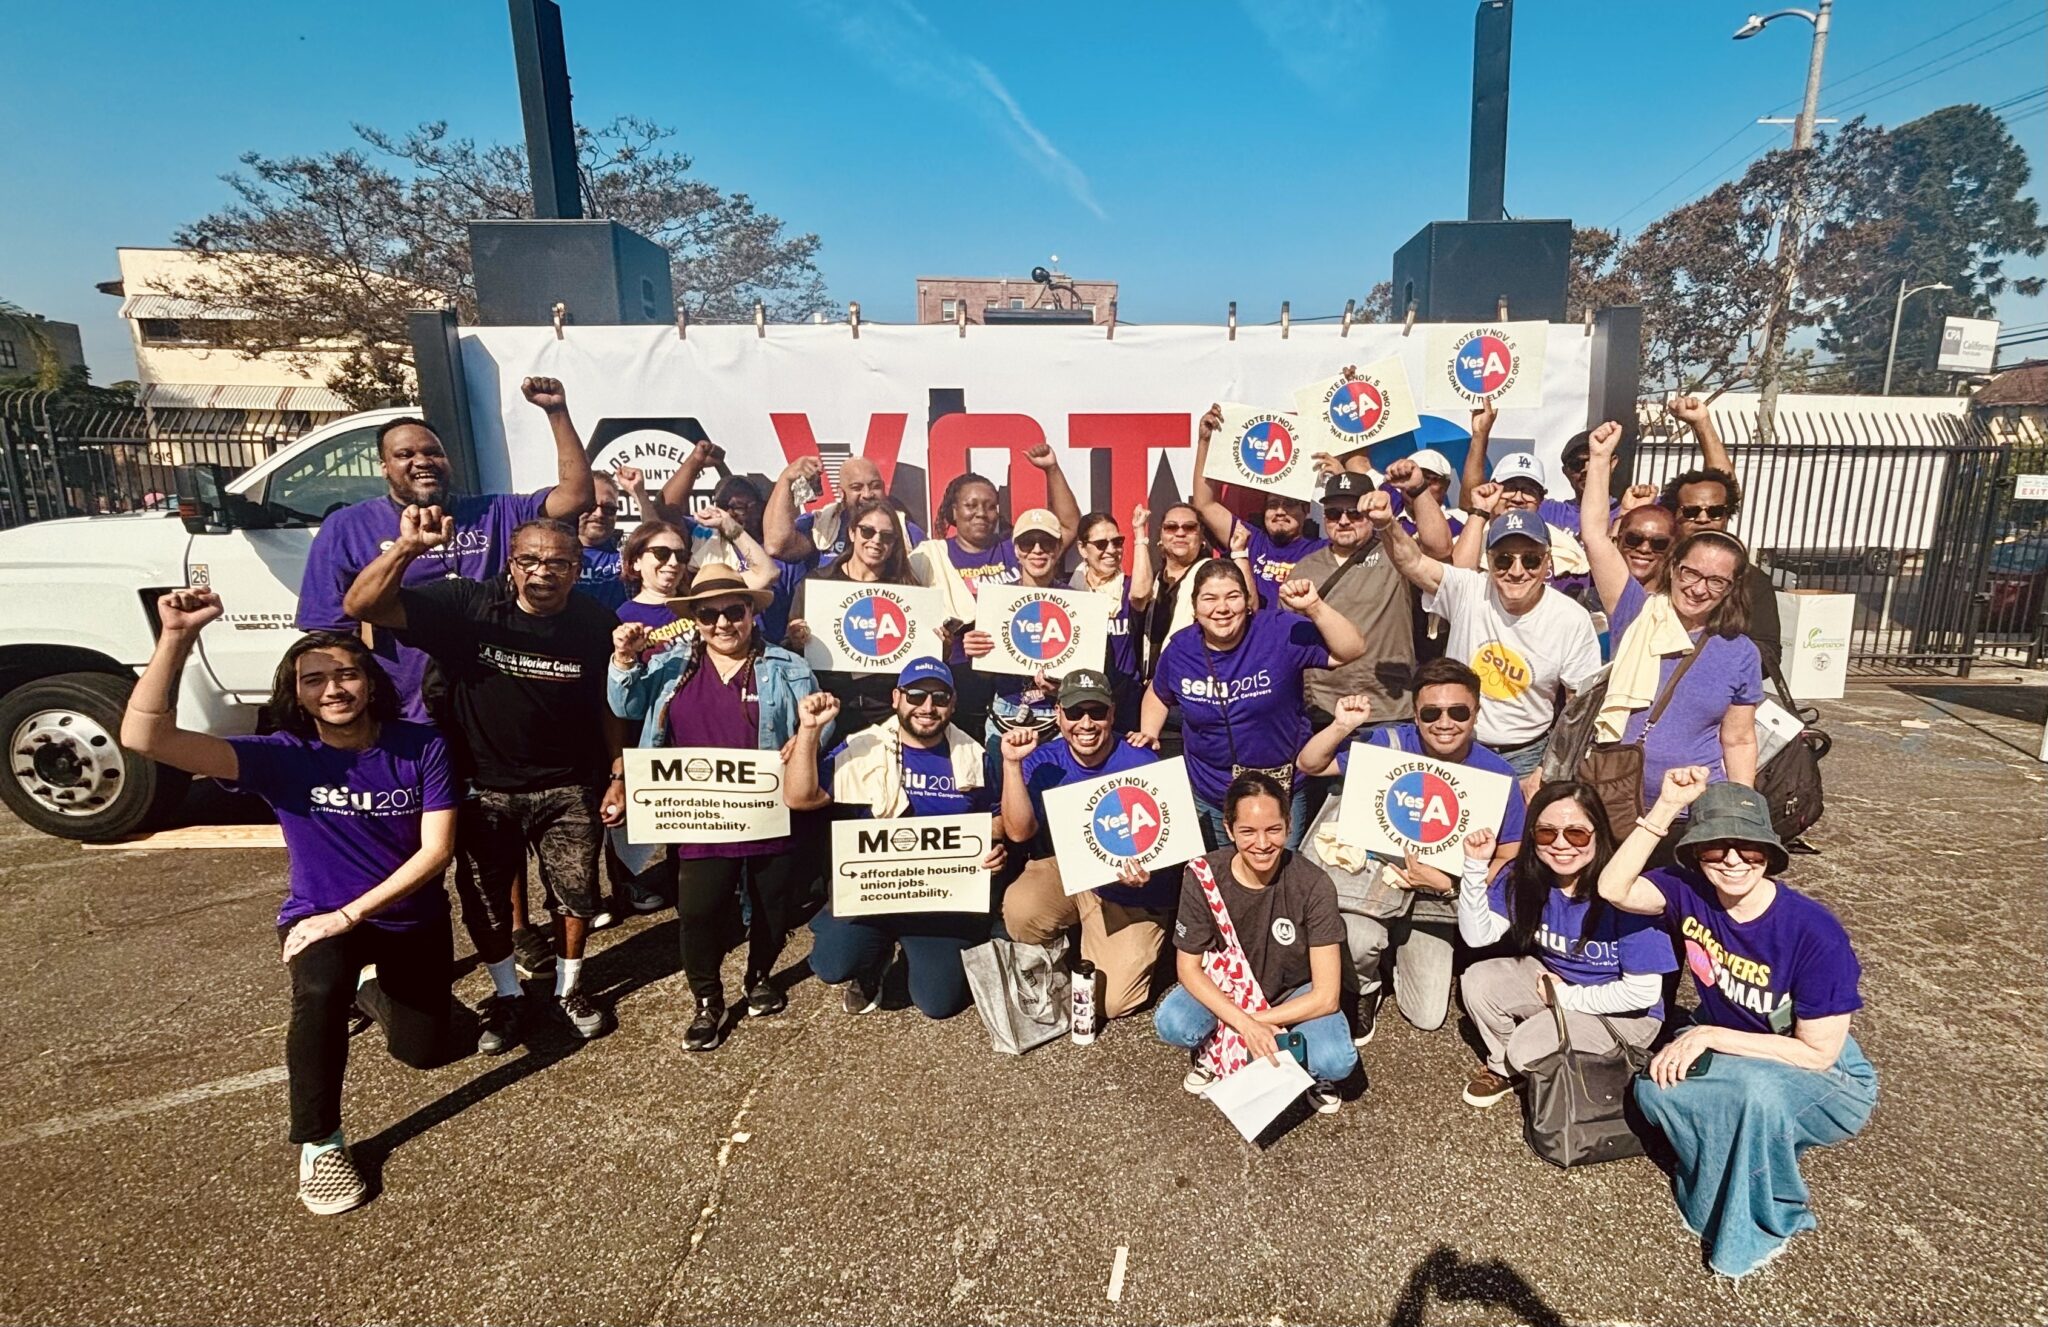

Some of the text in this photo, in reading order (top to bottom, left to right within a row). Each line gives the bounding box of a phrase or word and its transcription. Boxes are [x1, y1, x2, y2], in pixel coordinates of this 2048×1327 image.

[1453, 331, 1475, 351] VOTE
[1476, 328, 1489, 337] BY
[1509, 342, 1517, 350] 5
[1460, 356, 1484, 369] Yes
[1482, 351, 1506, 377] A
[1323, 382, 1341, 403] VOTE
[1333, 401, 1357, 417] Yes
[1359, 393, 1380, 418] A
[1242, 415, 1265, 430] VOTE
[1247, 436, 1269, 450] Yes
[1265, 438, 1286, 461] A
[603, 443, 686, 478] LOS ANGEL
[1518, 456, 1531, 469] LA
[1339, 474, 1351, 490] LA
[2021, 487, 2047, 496] EXIT
[1506, 514, 1523, 529] LA
[192, 570, 208, 584] 26
[840, 590, 865, 610] VOTE
[866, 588, 880, 596] BY
[903, 605, 912, 613] 5
[1008, 594, 1032, 613] VOTE
[1034, 592, 1047, 600] BY
[1069, 610, 1077, 618] 5
[216, 613, 293, 622] SILVERAD
[849, 615, 877, 630] Yes
[876, 613, 901, 639] A
[1016, 619, 1043, 633] Yes
[1041, 617, 1066, 643] A
[519, 655, 552, 670] Worker
[553, 661, 581, 673] Center
[1079, 673, 1094, 688] LA
[1181, 669, 1271, 698] seiu 2015
[651, 758, 756, 784] MORE
[1385, 762, 1416, 781] VOTE
[1417, 762, 1434, 772] BY
[1457, 790, 1468, 799] 5
[928, 775, 957, 791] 201
[654, 797, 779, 809] affordable housing.
[1085, 784, 1109, 813] VOTE
[1109, 777, 1122, 789] BY
[1151, 787, 1159, 796] 5
[655, 809, 725, 820] union jobs.
[1096, 812, 1129, 831] Yes
[1131, 802, 1158, 835] A
[1393, 790, 1425, 809] Yes
[1421, 794, 1451, 827] A
[655, 821, 751, 832] accountability.
[1136, 801, 1171, 865] HELAFED.ORG
[858, 826, 961, 854] MORE
[860, 864, 980, 879] affordable housing.
[860, 879, 929, 890] union jobs.
[860, 889, 953, 902] accountability.
